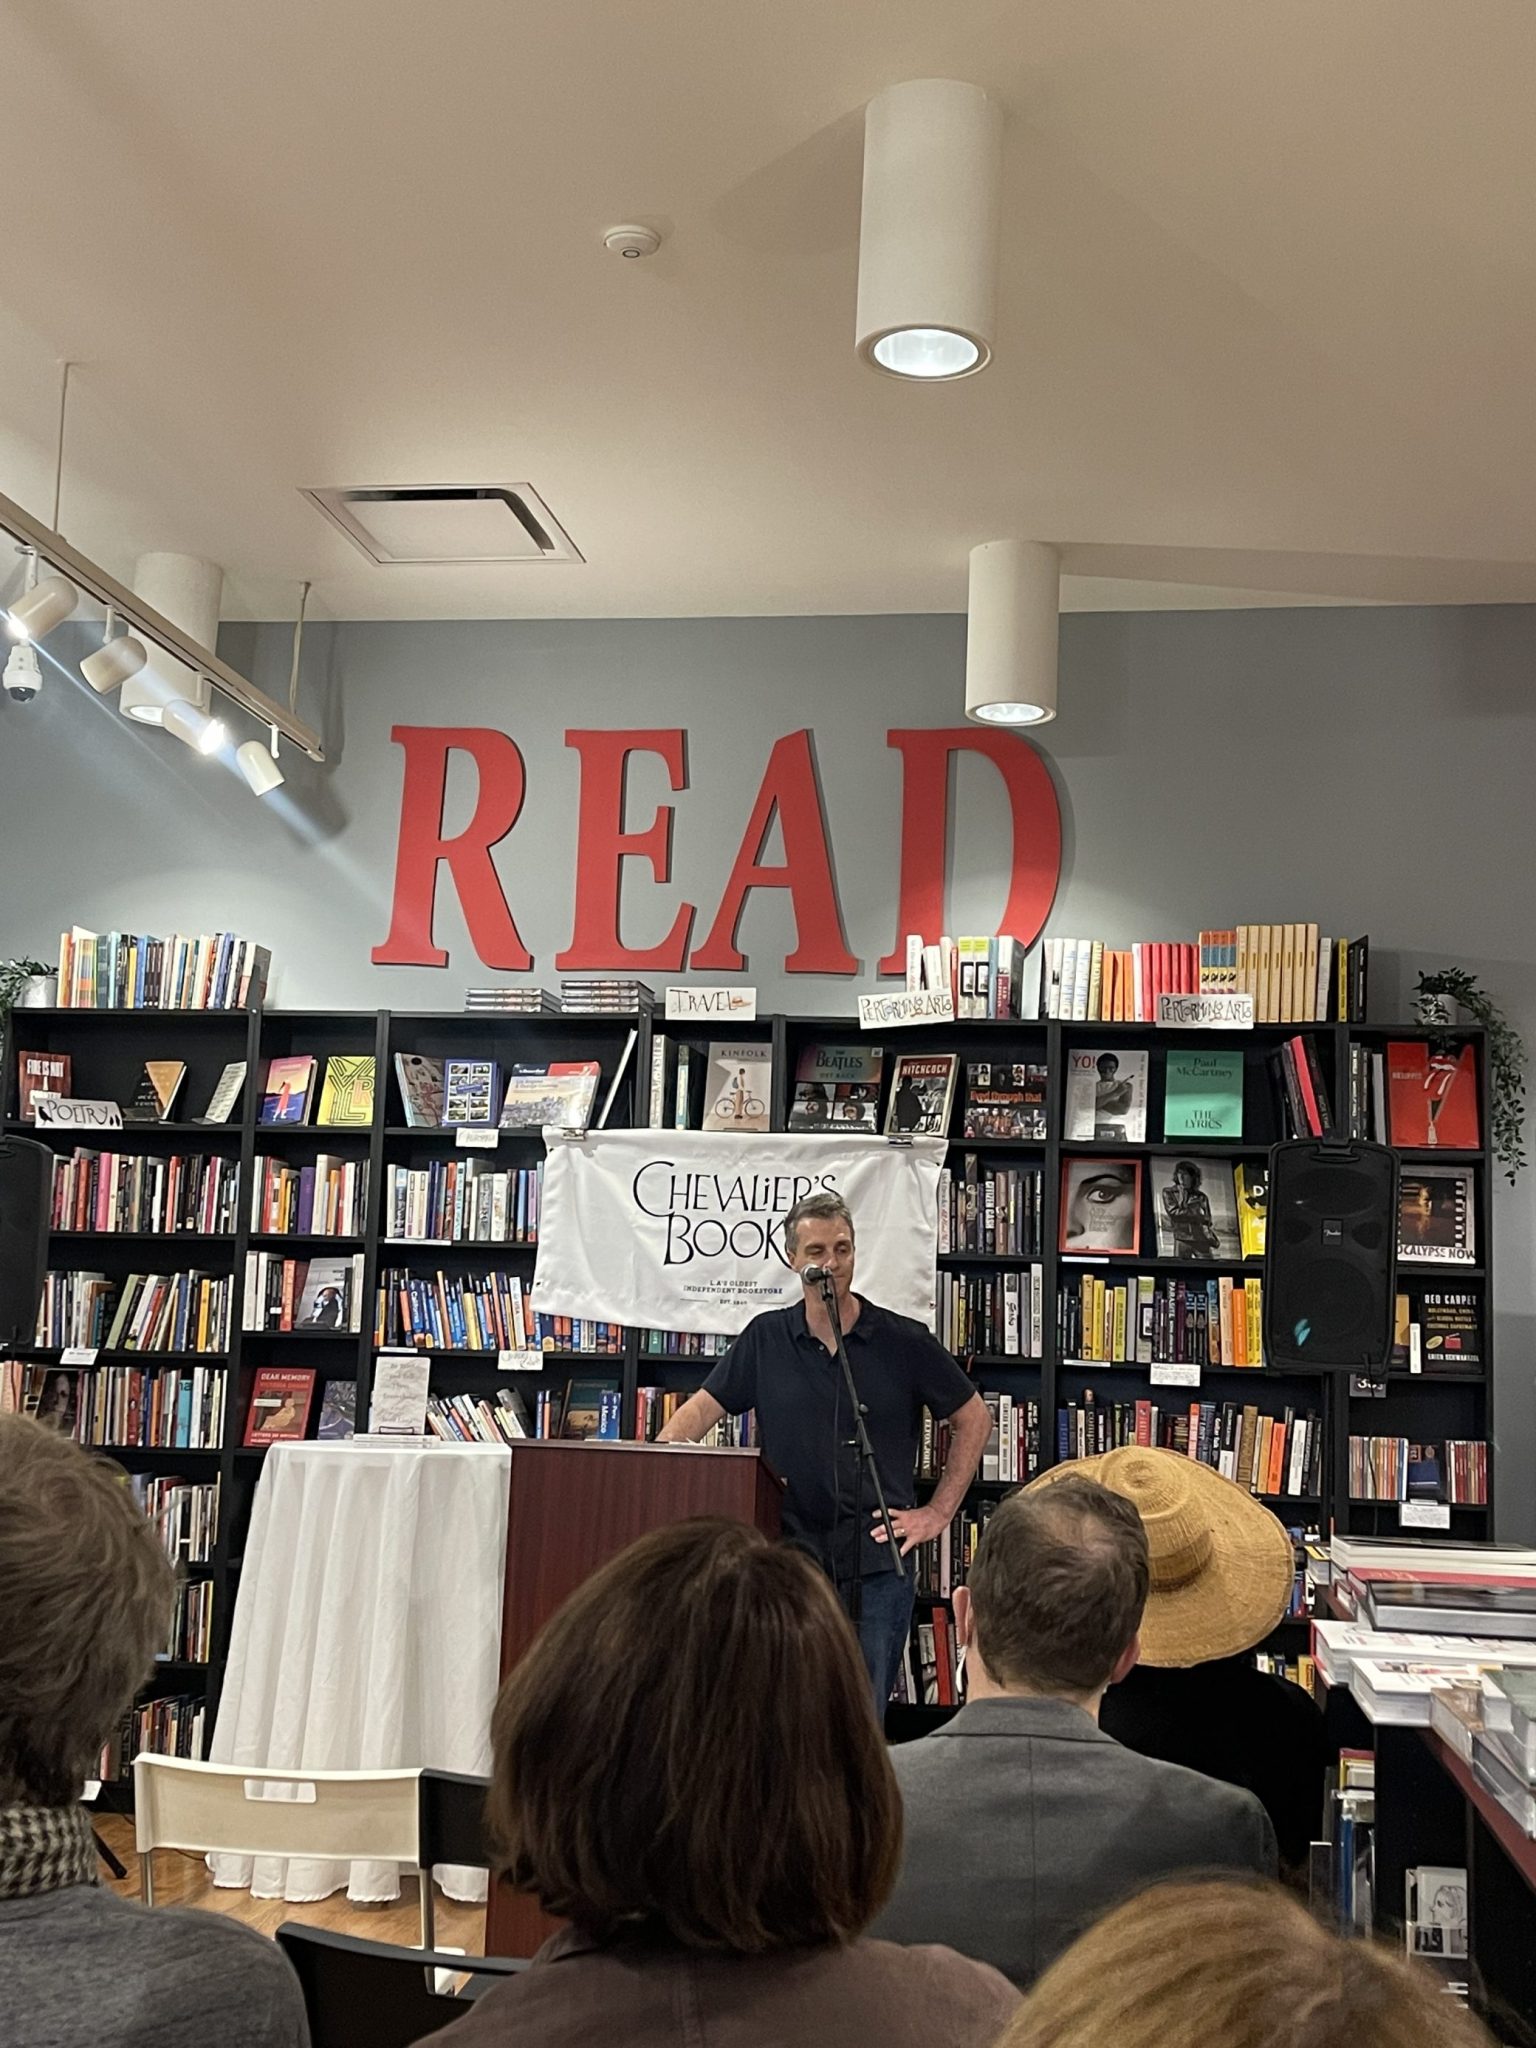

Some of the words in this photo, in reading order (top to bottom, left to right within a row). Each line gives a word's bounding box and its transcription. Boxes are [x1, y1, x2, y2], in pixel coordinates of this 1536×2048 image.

[371, 725, 1062, 974] READ
[669, 988, 738, 1014] TRAVEL
[721, 1050, 767, 1058] KINFOLK
[816, 1050, 863, 1070] BEATLES
[1072, 1055, 1096, 1069] YO!
[902, 1064, 948, 1075] HITCHCOCK
[1177, 1066, 1233, 1080] McCartney
[46, 1100, 109, 1125] POETRY
[1185, 1119, 1223, 1129] LYRICS
[985, 1209, 995, 1229] CASH
[663, 1213, 794, 1269] BOOK
[1448, 1248, 1476, 1259] NOW
[683, 1285, 735, 1294] INDEPENDENT
[737, 1287, 783, 1295] BOOKSTORE
[1168, 1281, 1176, 1318] PARASITE
[1424, 1294, 1441, 1305] RED
[1444, 1294, 1477, 1306] CARPET
[411, 1290, 420, 1323] California
[281, 1373, 311, 1381] MEMORY
[600, 1405, 609, 1434] Mexico
[1213, 1417, 1221, 1436] Guitar
[923, 1418, 931, 1444] ELTON
[922, 1444, 931, 1470] JOHN
